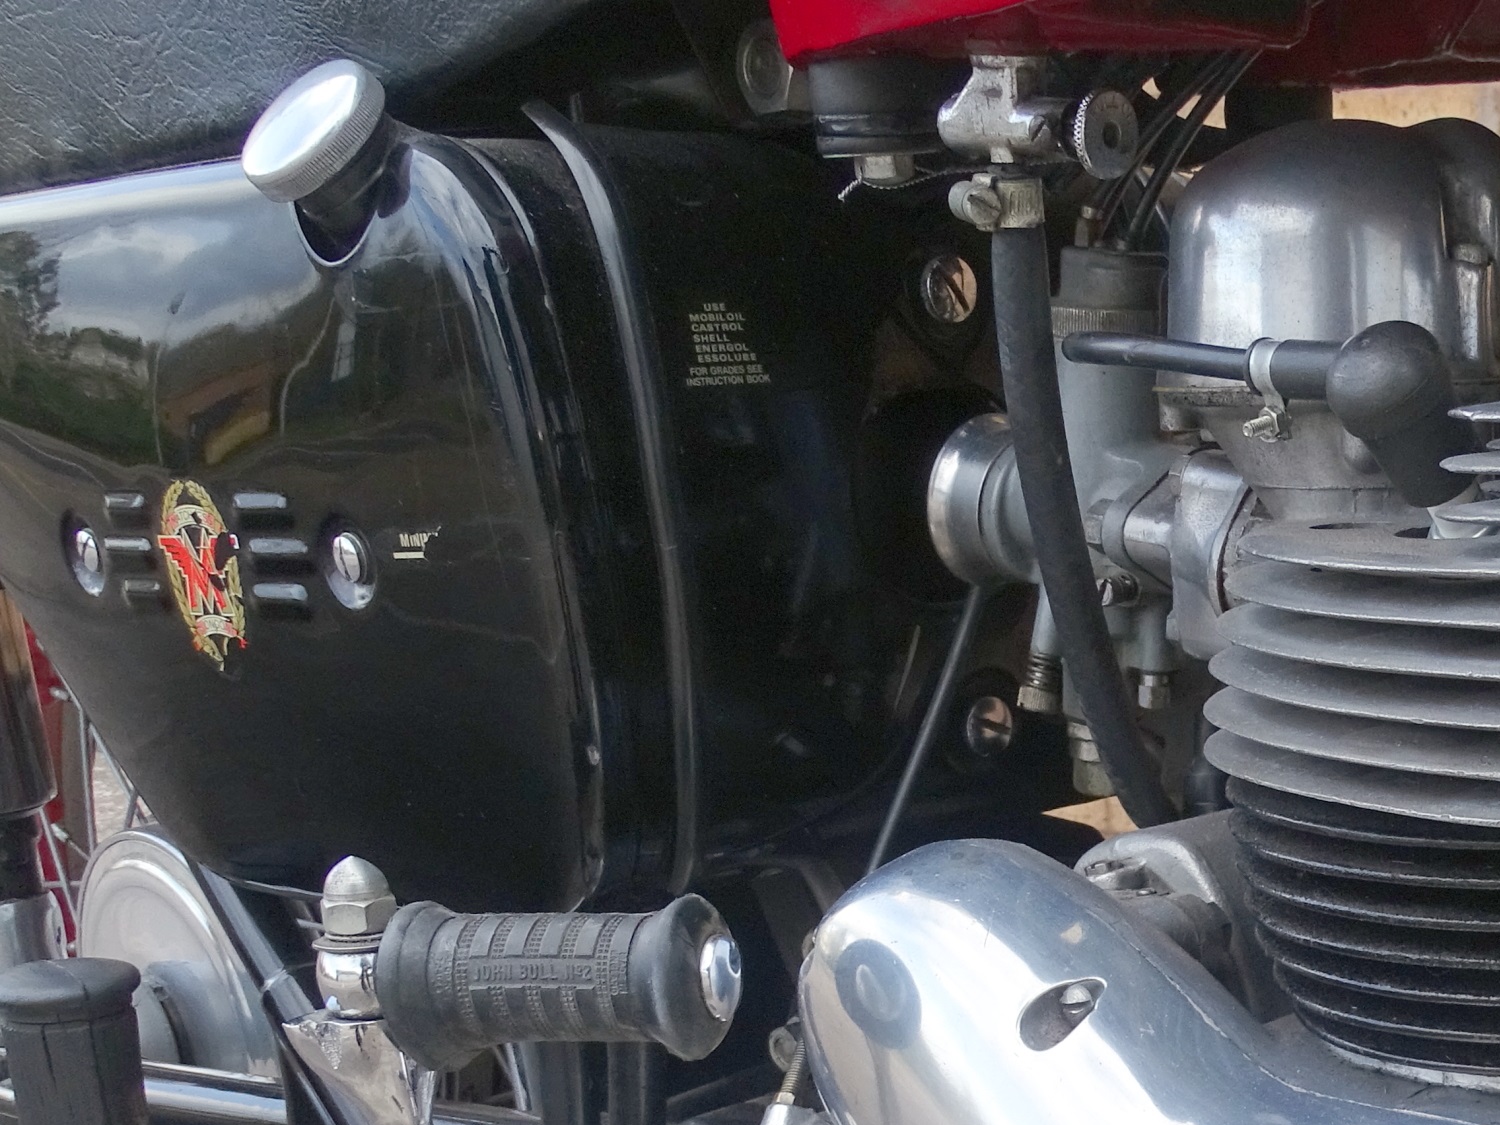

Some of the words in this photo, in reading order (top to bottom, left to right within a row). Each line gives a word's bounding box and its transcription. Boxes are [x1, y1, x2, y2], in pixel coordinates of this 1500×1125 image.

[703, 303, 726, 312] USE
[691, 323, 744, 332] CASTROL
[693, 334, 730, 343] SHELL
[695, 343, 749, 353] ENERGOL
[697, 353, 757, 363] ESSOLUBE
[690, 367, 708, 376] FOR
[710, 365, 745, 375] GRADES
[746, 364, 763, 374] SEE
[686, 376, 744, 386] INSTRUCTION
[746, 374, 771, 384] BOOK
[474, 963, 513, 981] JOHN
[520, 963, 559, 981] BULL
